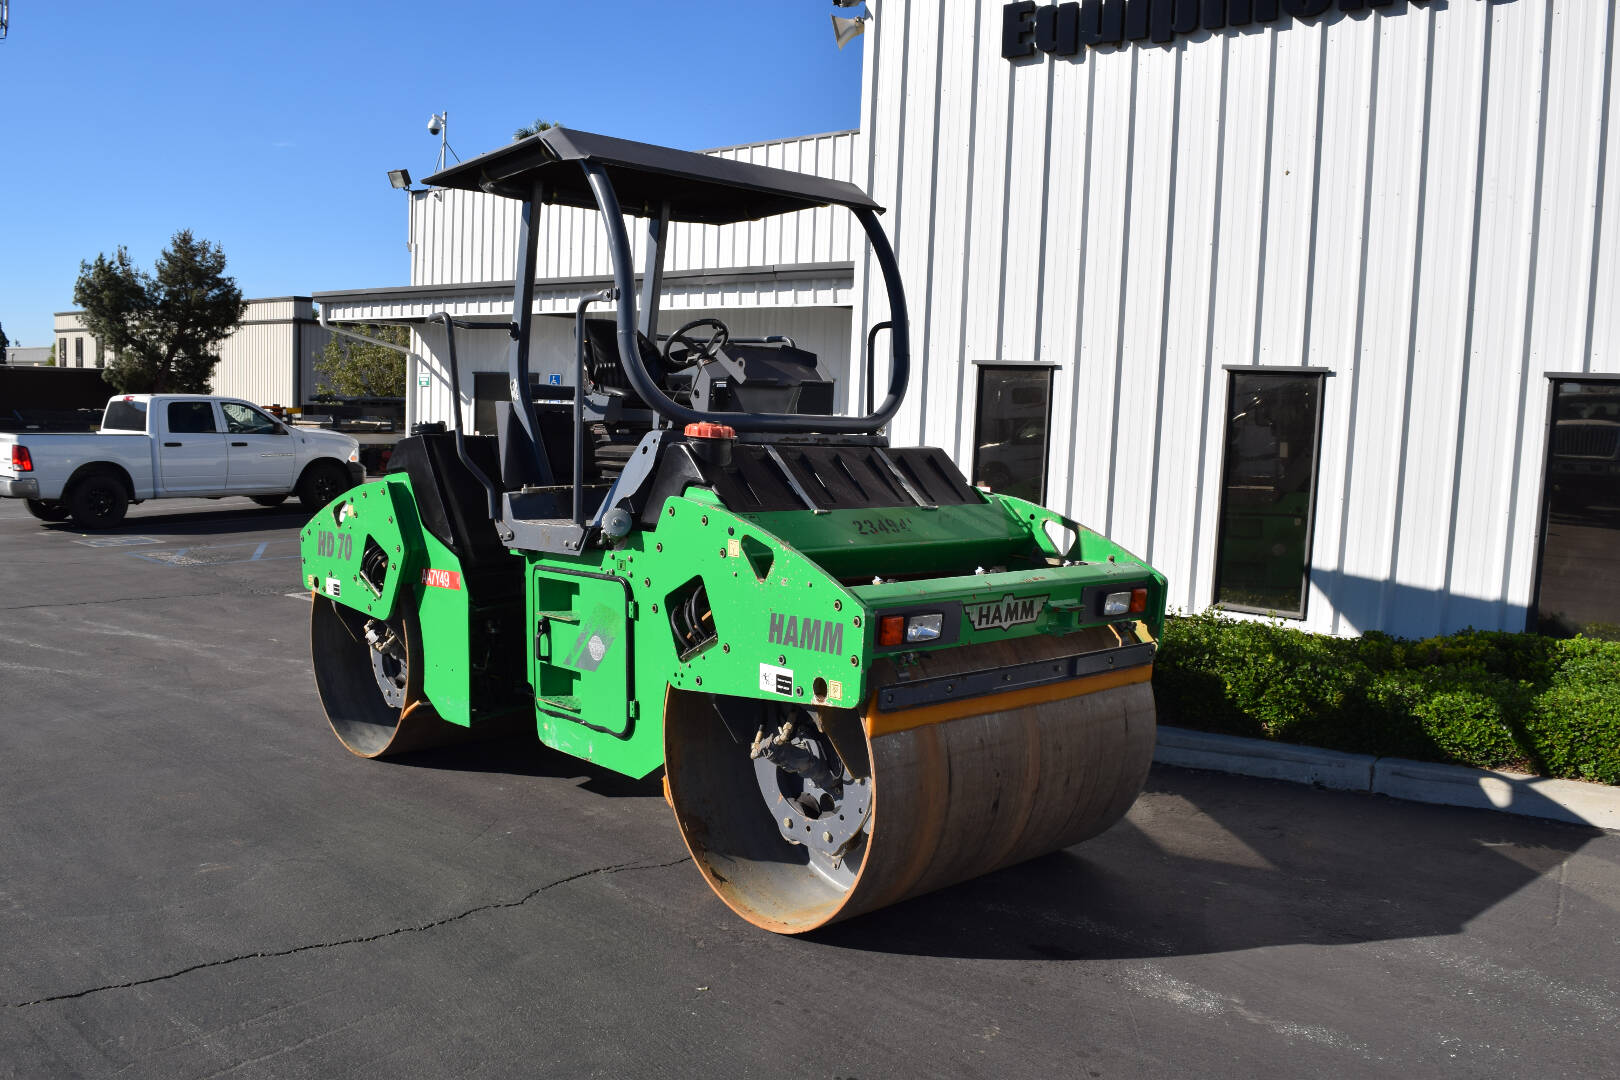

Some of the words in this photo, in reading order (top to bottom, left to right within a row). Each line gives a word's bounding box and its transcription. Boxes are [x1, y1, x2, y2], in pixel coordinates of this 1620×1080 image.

[318, 530, 335, 557] HD
[337, 533, 352, 560] 70
[977, 599, 1035, 626] HAMM
[768, 612, 844, 656] HAMM
